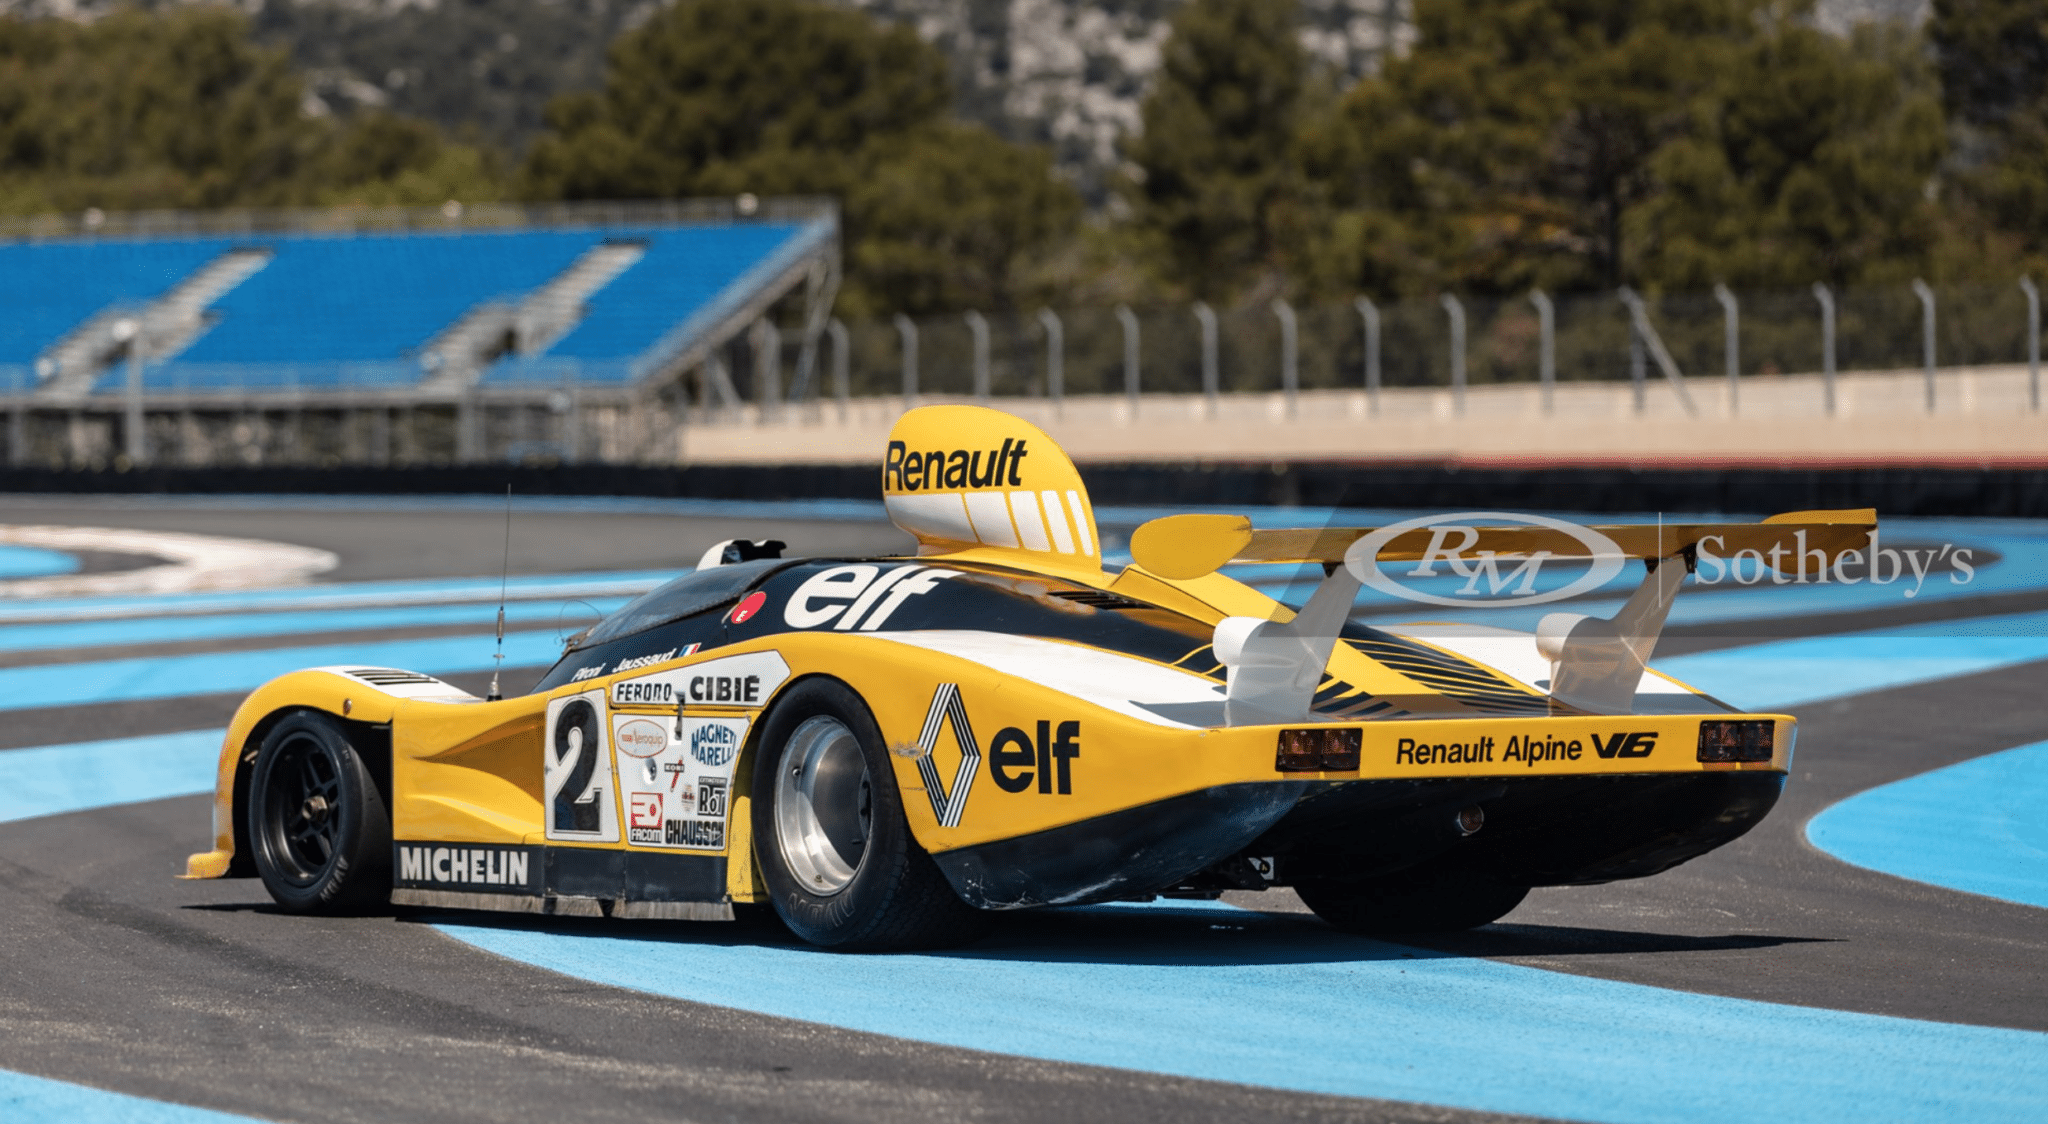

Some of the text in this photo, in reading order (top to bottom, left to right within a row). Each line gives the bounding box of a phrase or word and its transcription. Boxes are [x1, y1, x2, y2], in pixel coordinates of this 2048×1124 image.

[885, 438, 1028, 491] Renault
[783, 564, 967, 631] elf
[612, 647, 678, 673] Jaussaud
[553, 697, 603, 835] 2
[989, 720, 1080, 795] elf
[1396, 732, 1659, 767] Renault Alpine V6
[665, 819, 724, 847] CHAUSSON
[400, 846, 529, 885] MICHELIN
